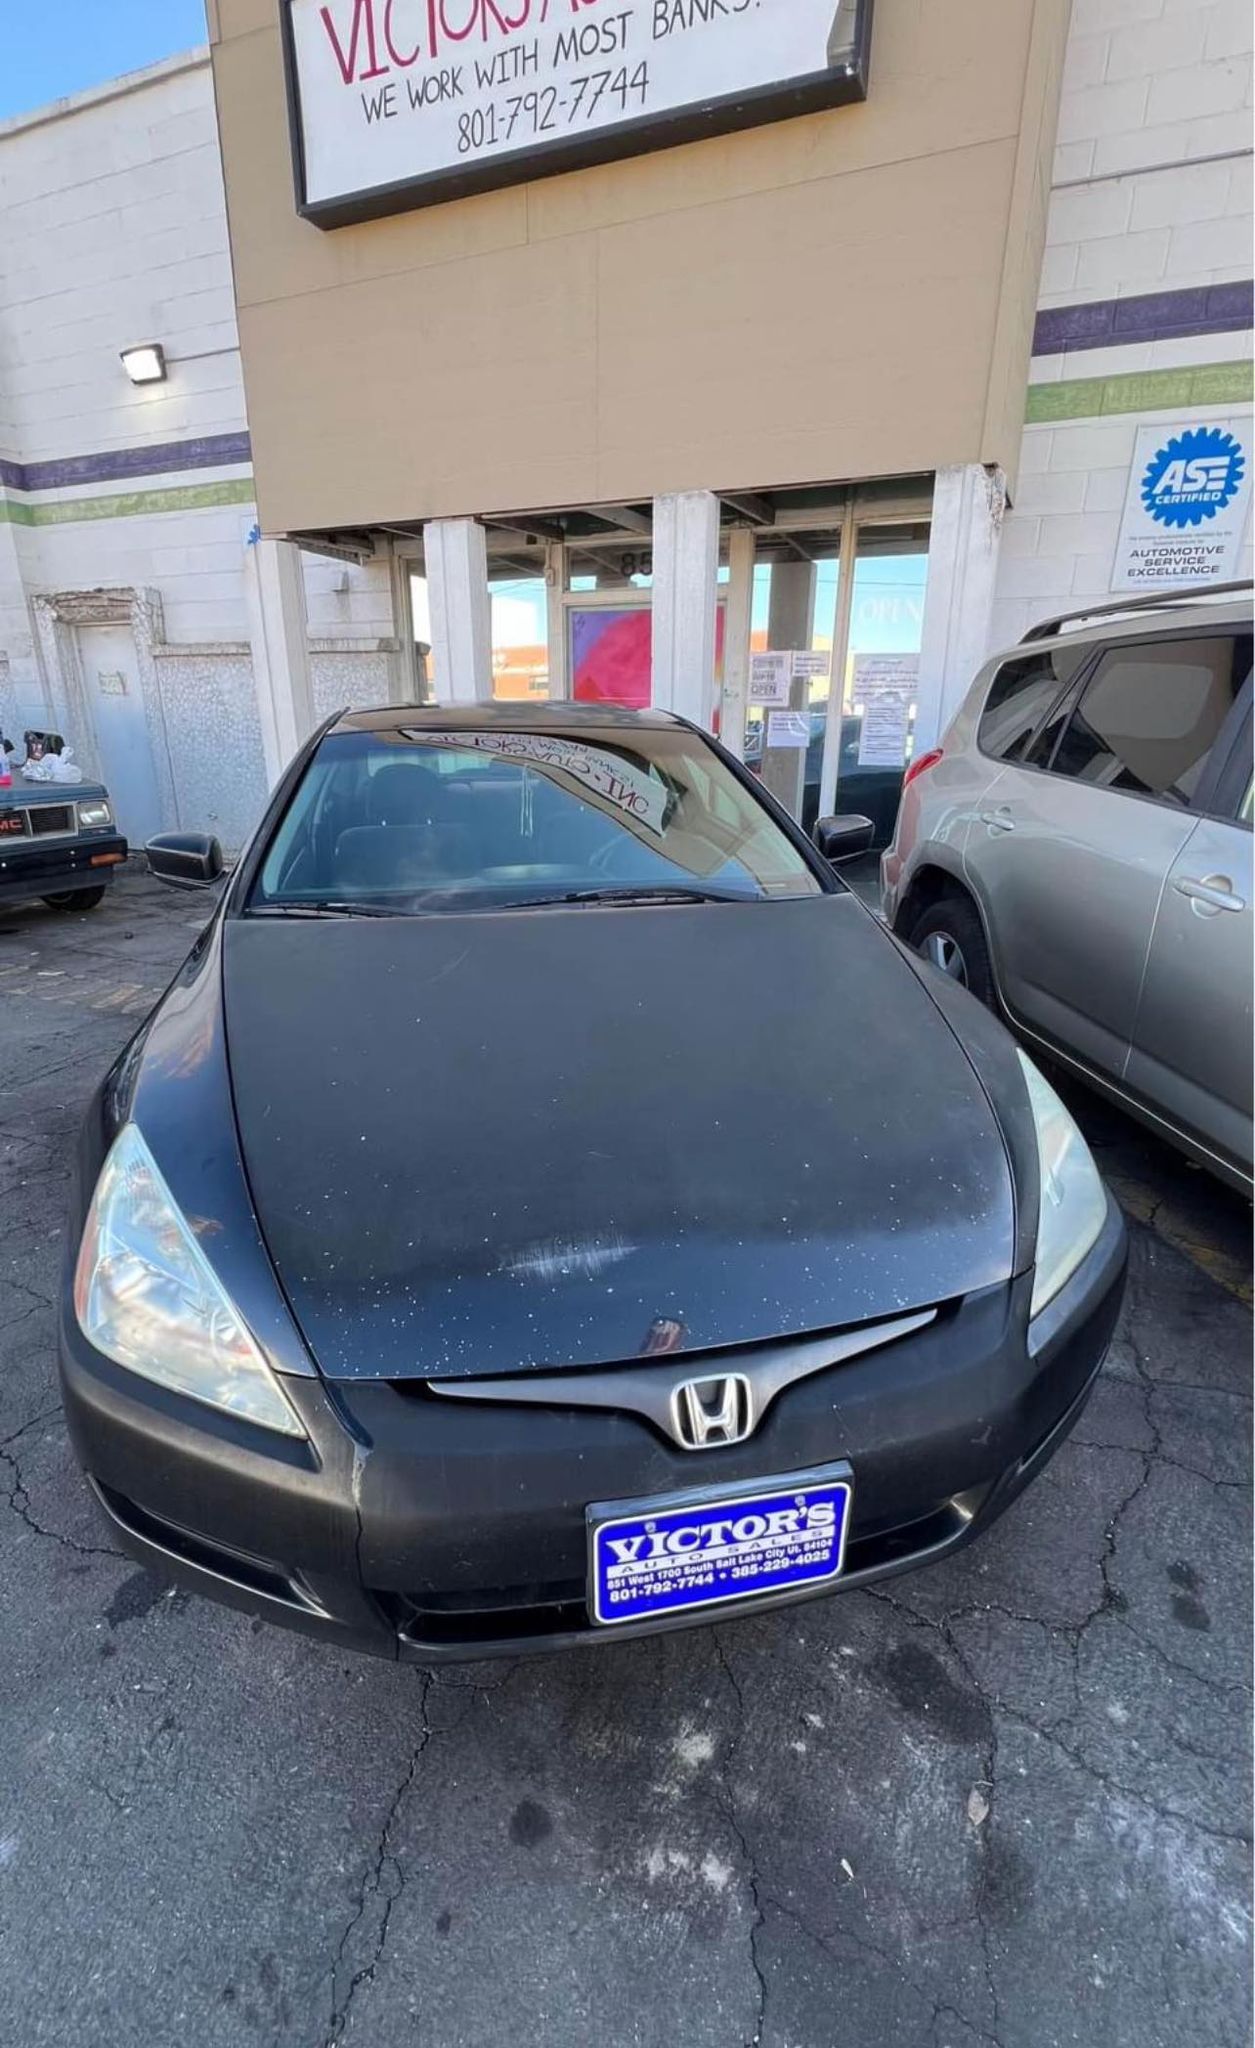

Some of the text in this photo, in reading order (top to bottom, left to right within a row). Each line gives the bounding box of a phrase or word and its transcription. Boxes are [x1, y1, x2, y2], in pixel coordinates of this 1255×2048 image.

[361, 83, 398, 125] WE
[407, 65, 464, 110] WORK
[474, 38, 538, 90] WITH
[553, 10, 634, 68] MOST
[458, 60, 650, 153] 801-792-7744
[1152, 455, 1231, 495] ASE
[1155, 491, 1222, 504] CERTIFIED
[1127, 565, 1221, 577] EXCELLENCE
[1130, 545, 1225, 558] AUTOMOTIVE
[1144, 556, 1207, 567] SERVICE
[606, 1502, 836, 1563] VICTOR'S
[622, 1530, 823, 1574] AUTO SALES
[628, 1572, 655, 1586] West
[657, 1568, 682, 1580] 1700
[684, 1562, 714, 1576] South
[738, 1552, 763, 1564] Lake
[765, 1548, 785, 1560] City
